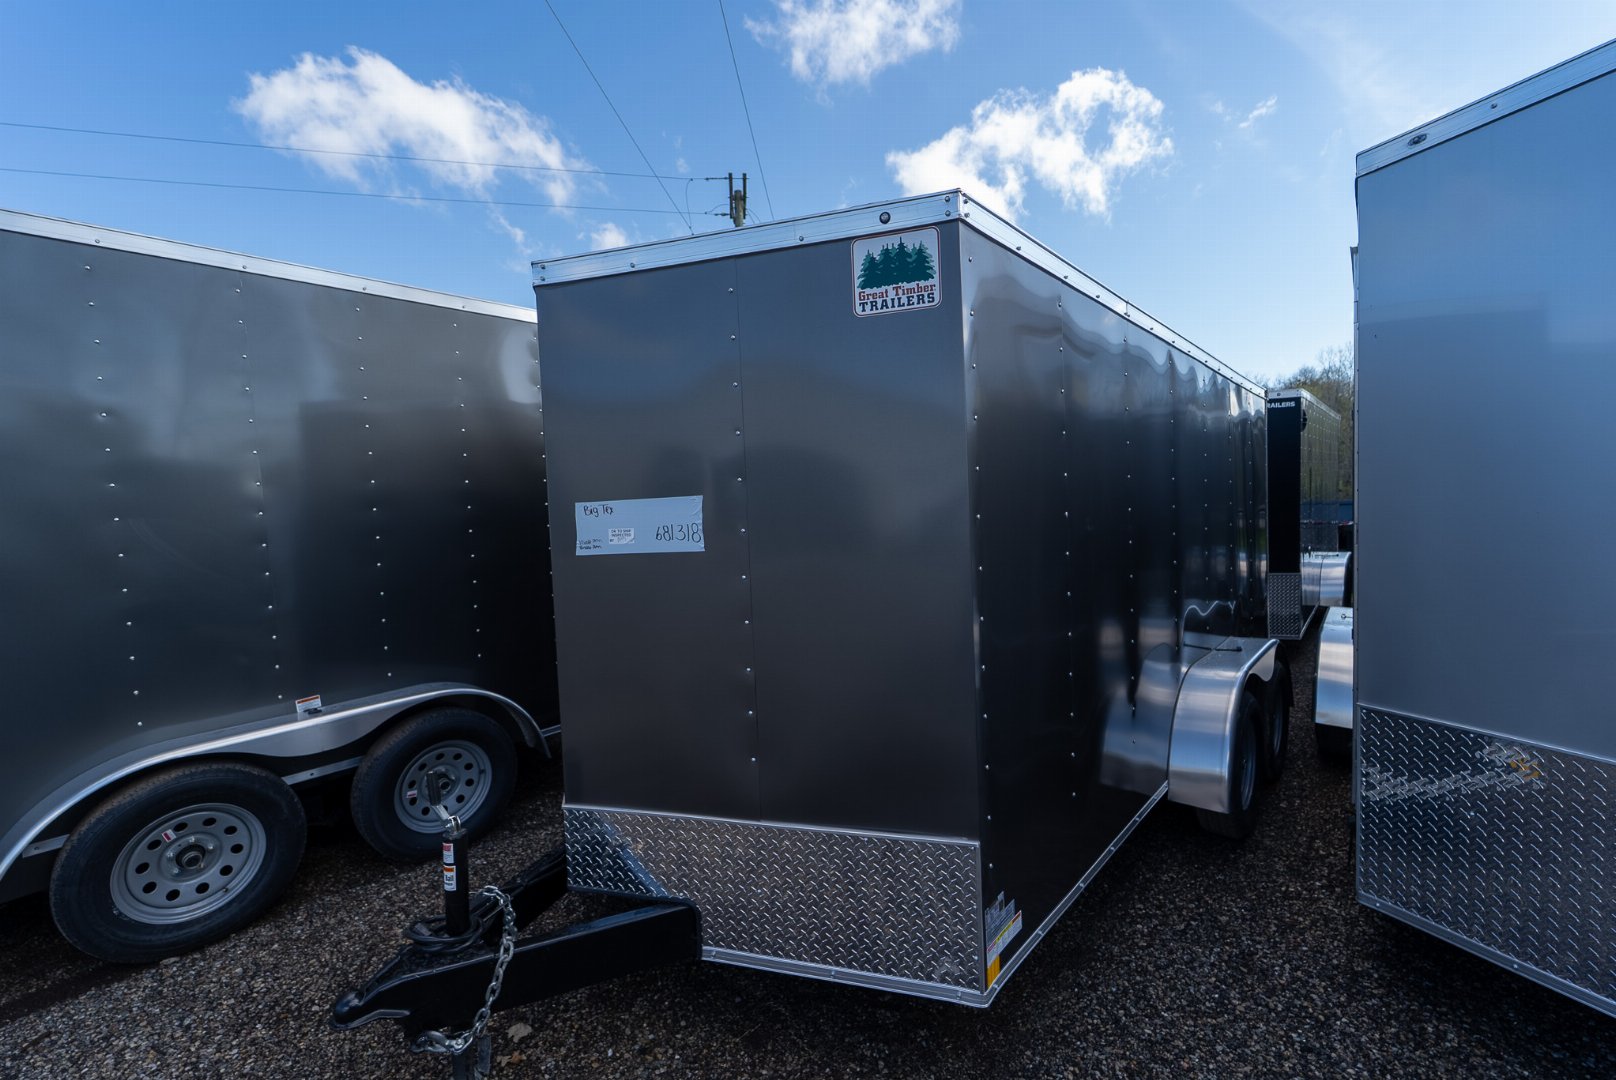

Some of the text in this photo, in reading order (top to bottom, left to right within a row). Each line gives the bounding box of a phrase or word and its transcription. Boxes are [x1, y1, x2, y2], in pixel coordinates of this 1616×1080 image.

[858, 283, 936, 302] Great Timber
[858, 292, 936, 312] TRAILERS
[583, 505, 599, 518] Big
[655, 522, 702, 543] 681318
